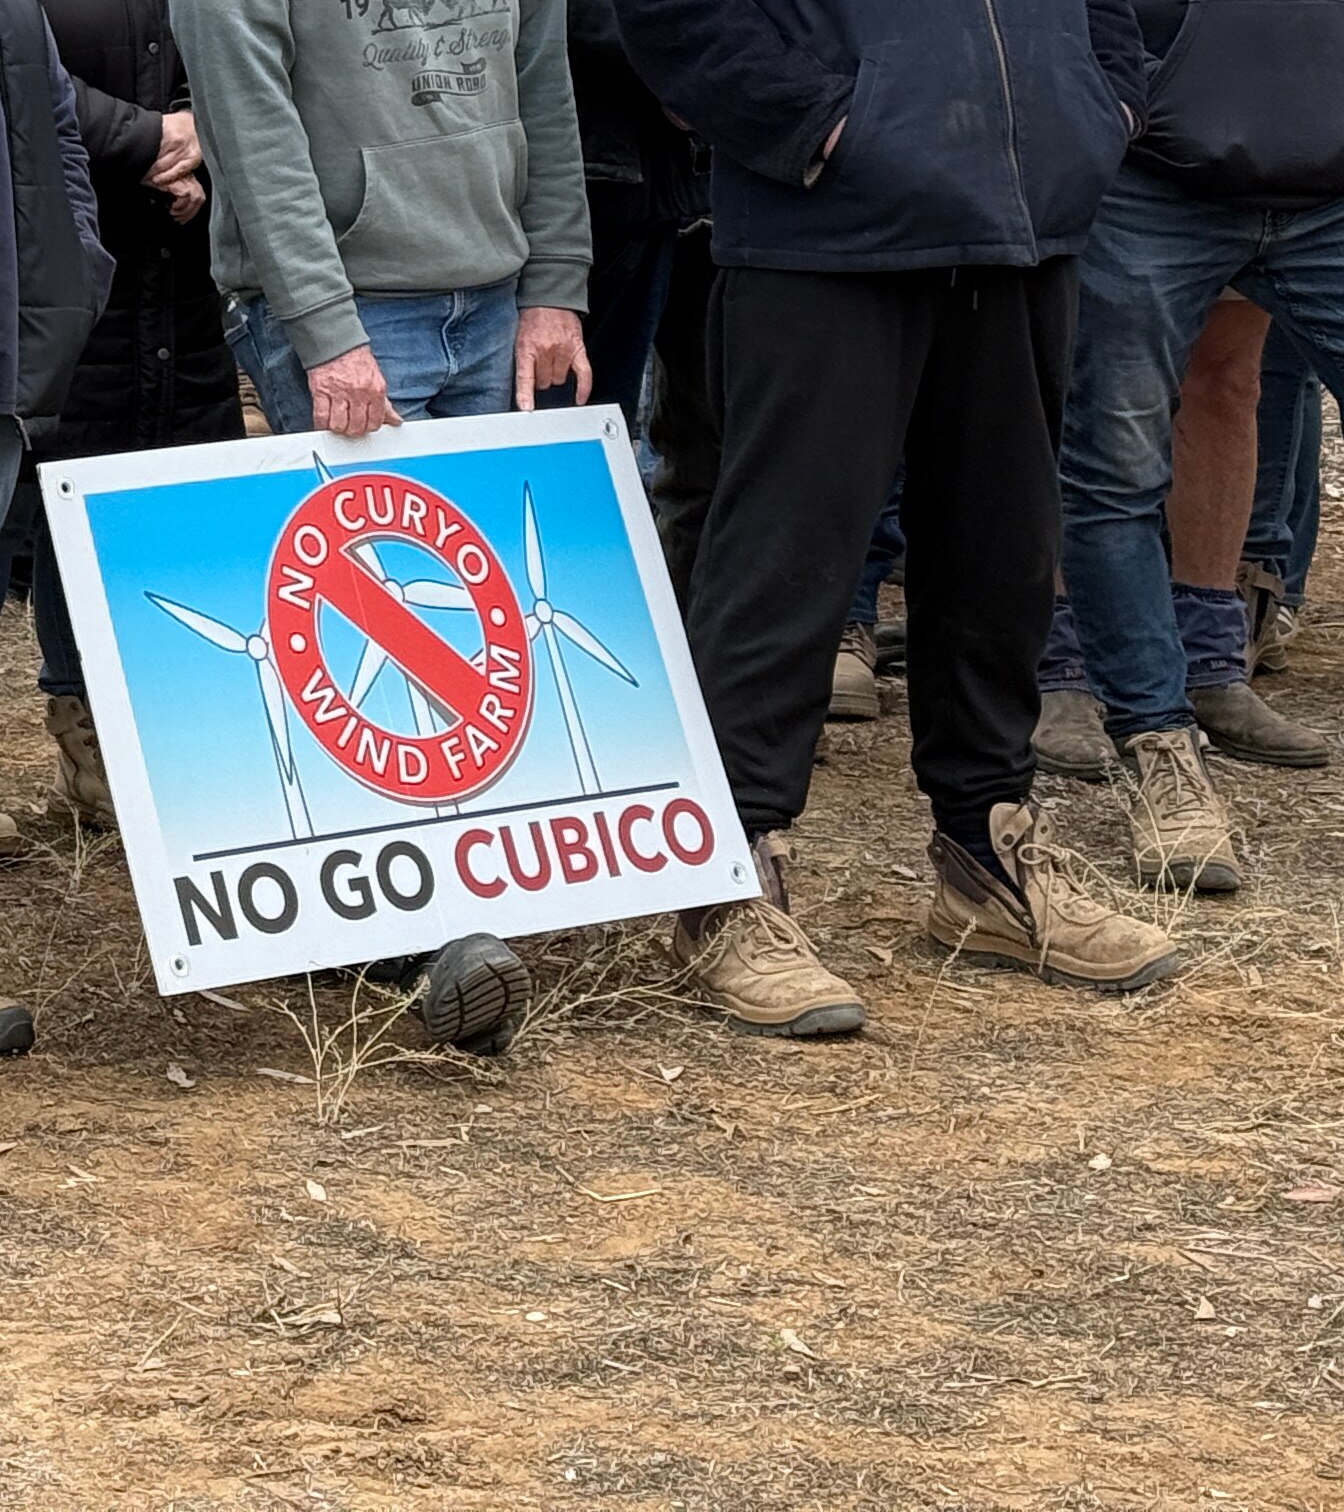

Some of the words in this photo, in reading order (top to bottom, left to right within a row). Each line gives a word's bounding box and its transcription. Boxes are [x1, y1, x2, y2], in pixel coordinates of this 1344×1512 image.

[362, 37, 430, 71] Quality
[412, 74, 452, 92] UNION
[277, 524, 329, 610] NO
[333, 485, 490, 585] CURYO
[300, 667, 429, 784] WIND
[440, 643, 522, 780] FARM
[173, 861, 299, 947] NO
[319, 840, 436, 921] GO
[454, 797, 716, 899] CUBICO
